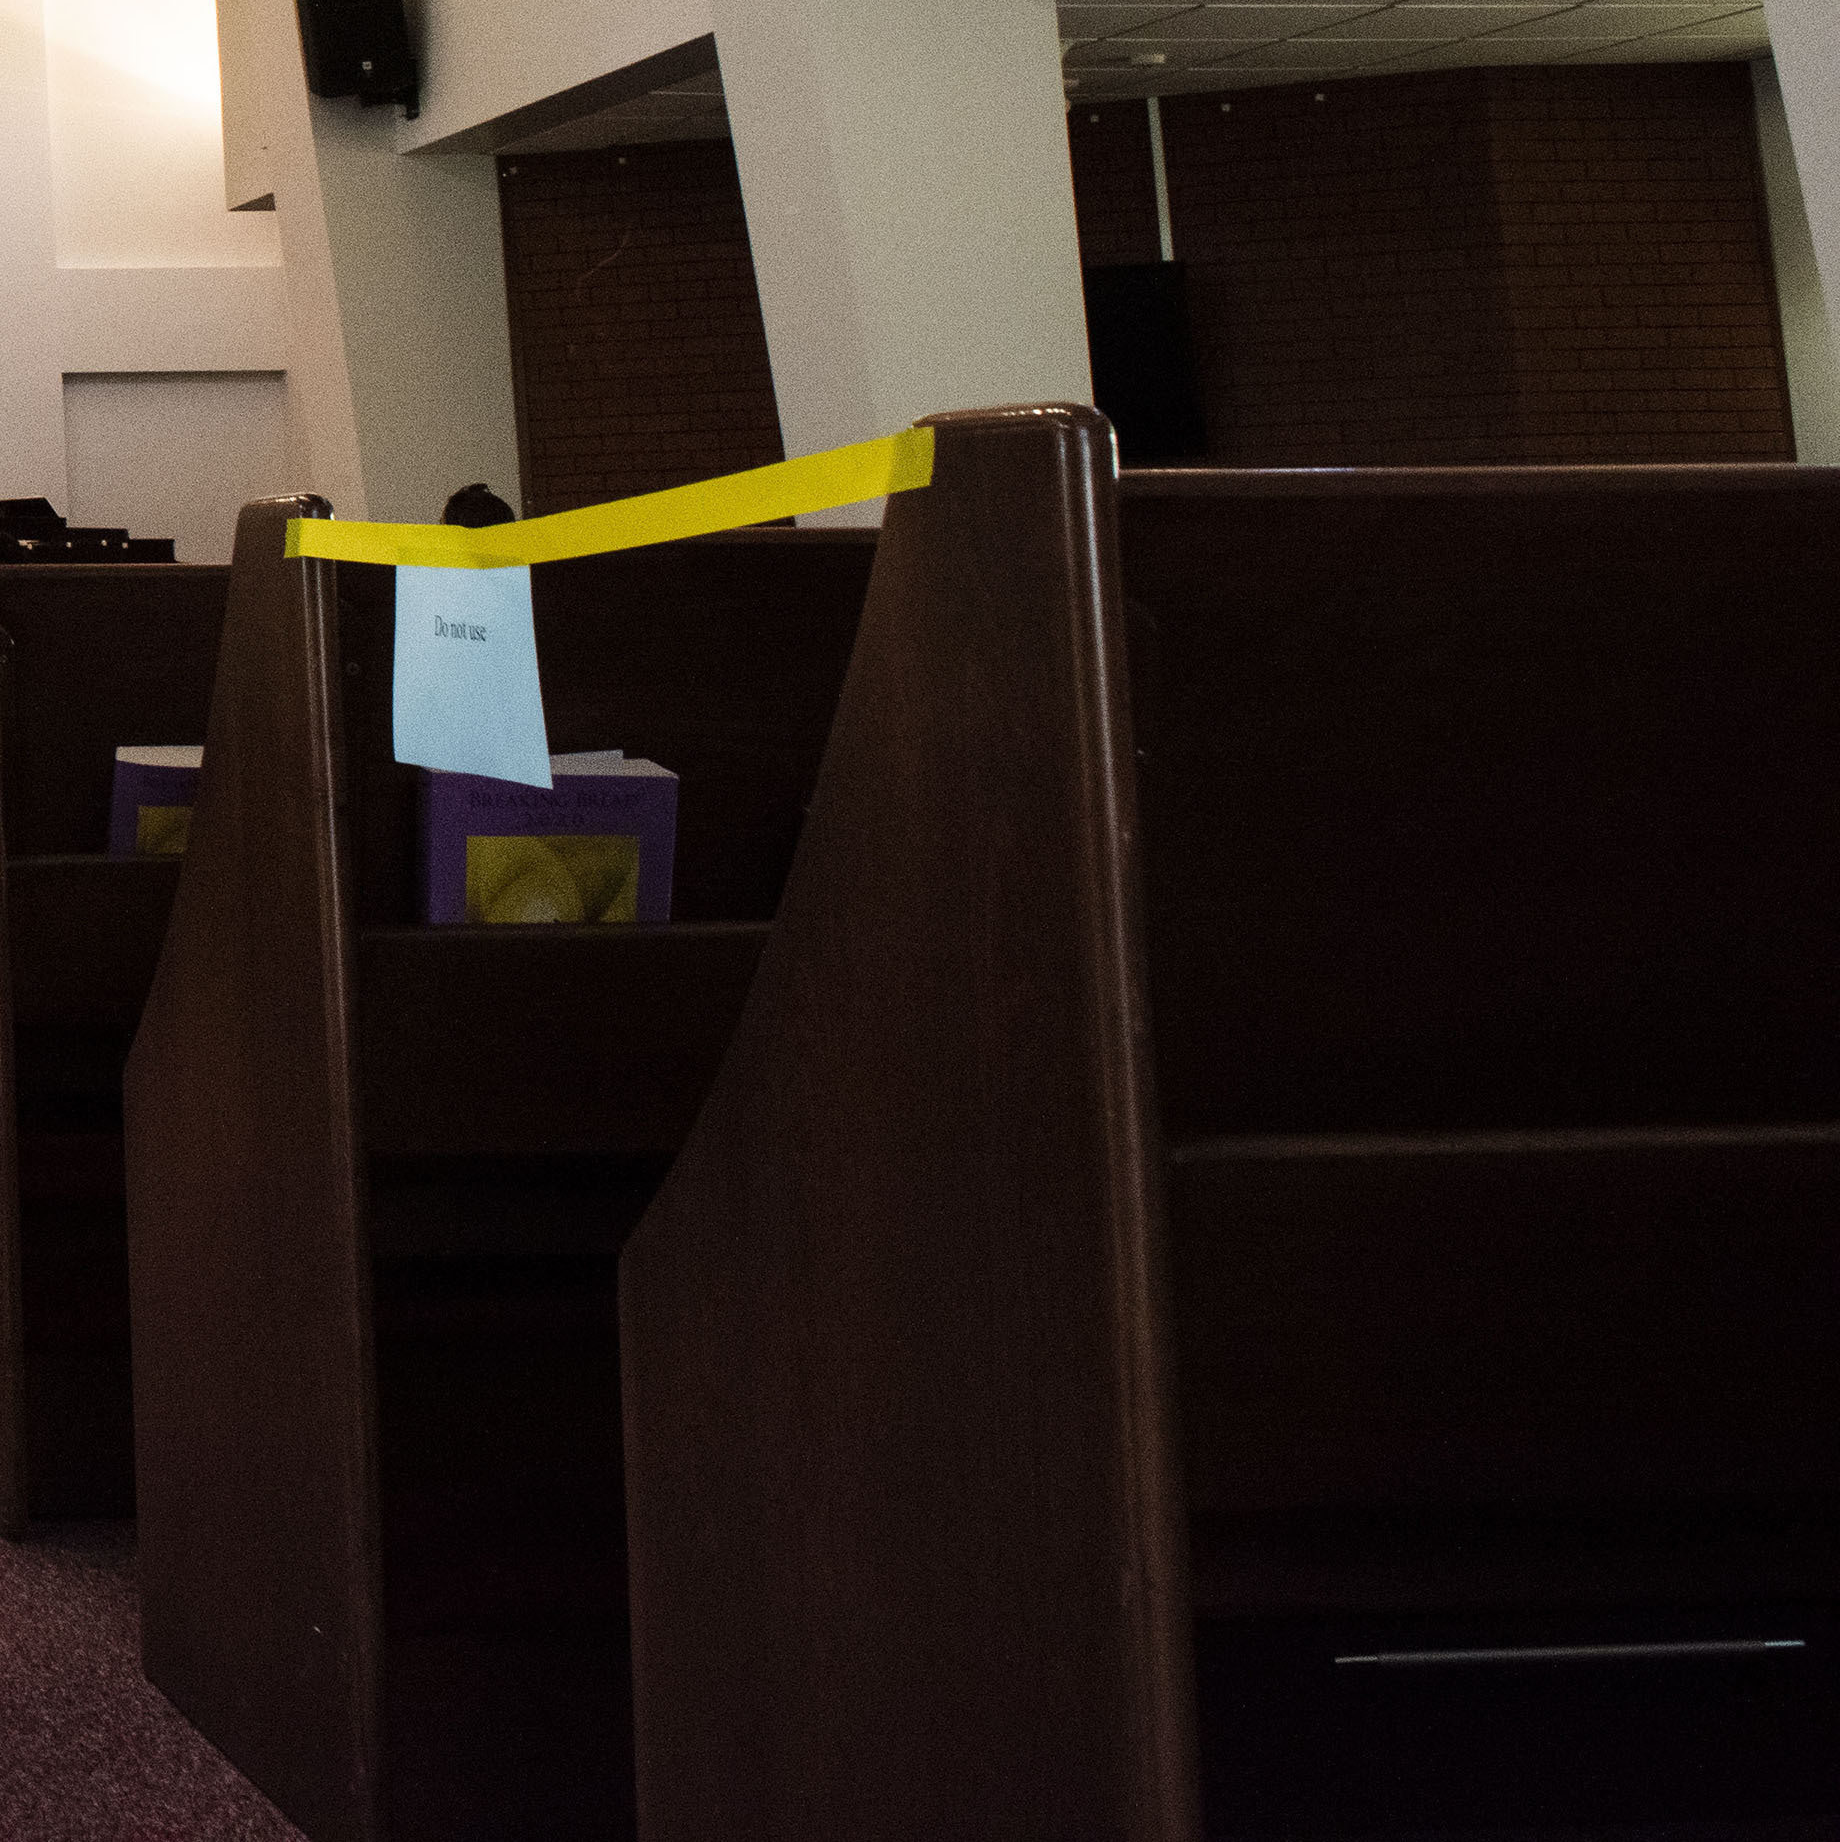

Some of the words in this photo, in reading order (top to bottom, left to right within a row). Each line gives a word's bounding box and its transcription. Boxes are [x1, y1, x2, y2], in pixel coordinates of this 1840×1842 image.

[434, 614, 449, 638] Do
[450, 621, 467, 641] not
[468, 624, 487, 644] use
